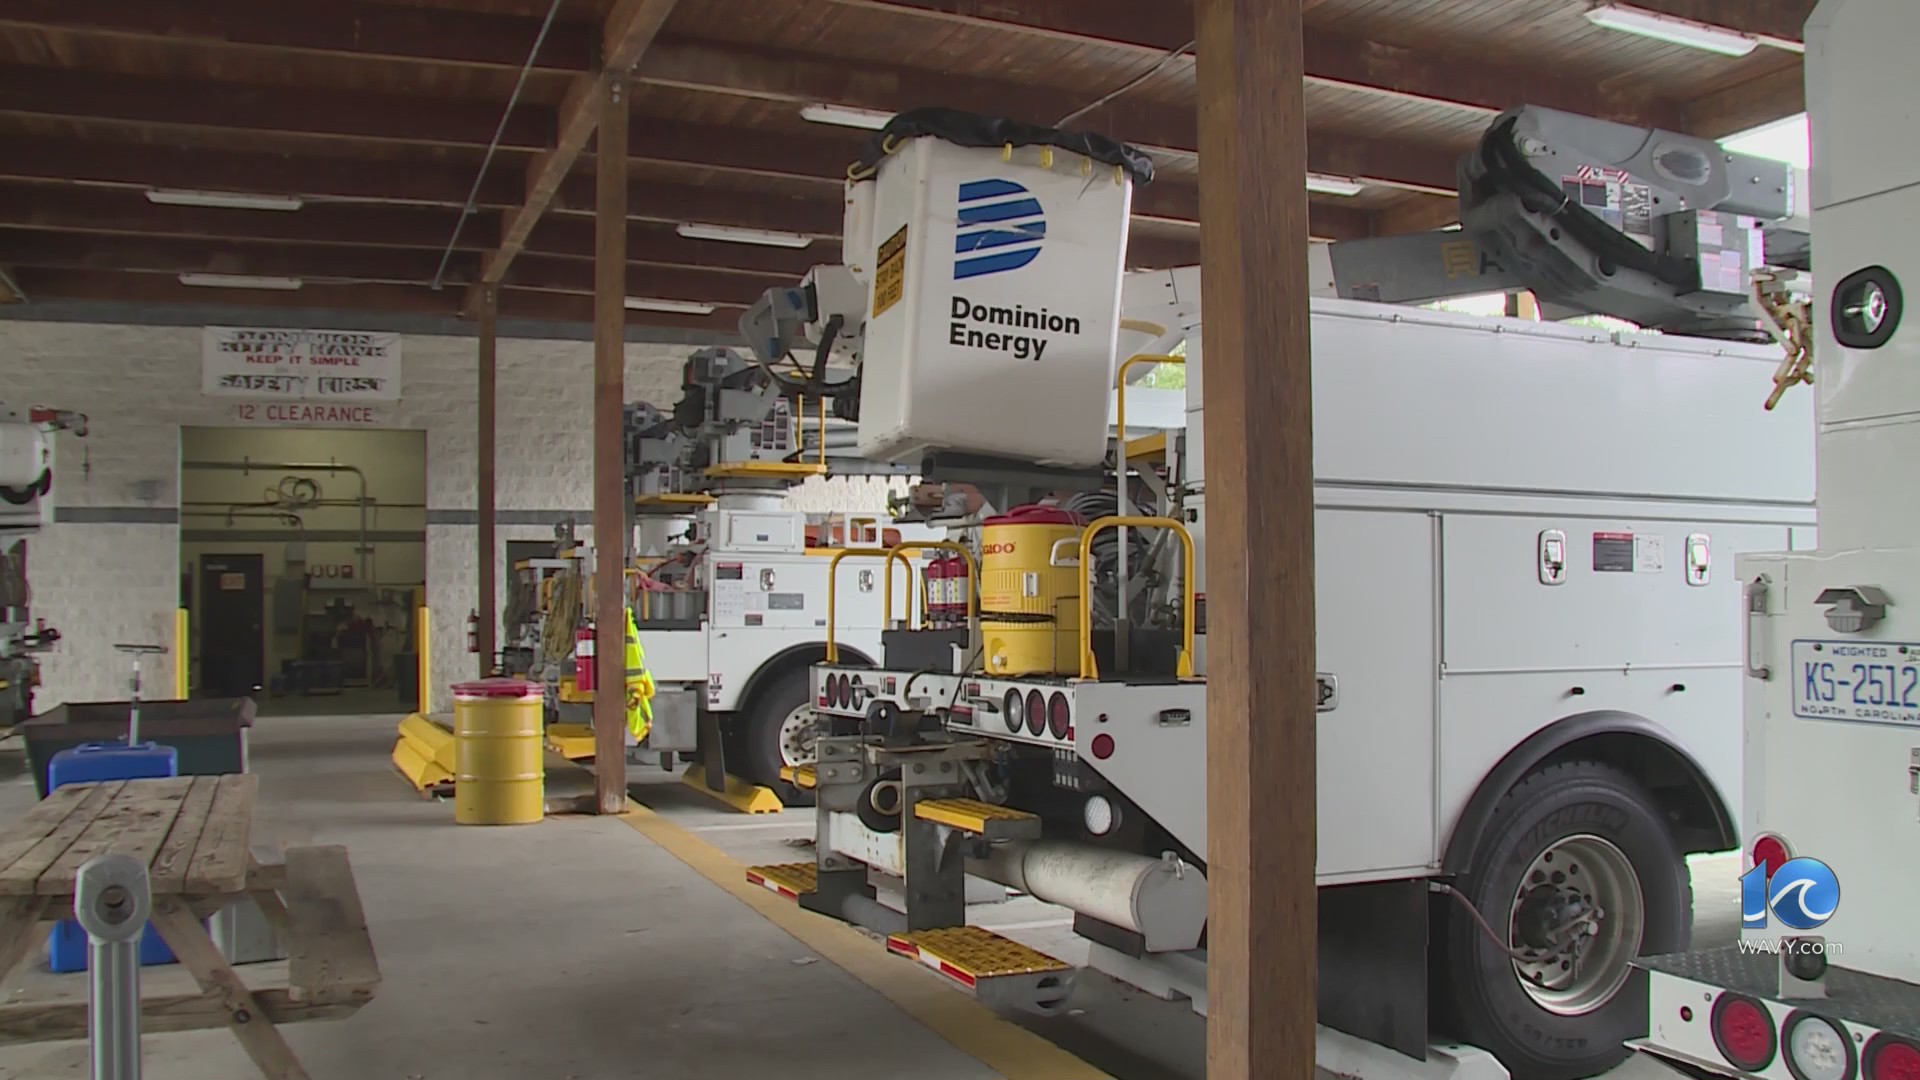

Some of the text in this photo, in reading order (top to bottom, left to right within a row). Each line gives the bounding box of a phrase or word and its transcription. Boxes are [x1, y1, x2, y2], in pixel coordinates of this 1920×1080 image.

[951, 296, 1080, 334] Dominion
[949, 322, 1047, 361] Energy
[246, 355, 360, 366] KEEP IT SIMPLE
[219, 375, 387, 395] SAFETY FIRST
[266, 405, 374, 422] CLEARANCE
[1832, 646, 1887, 658] WEIGHTED
[1805, 661, 1918, 708] KS-2512
[1801, 705, 1847, 716] NORTH
